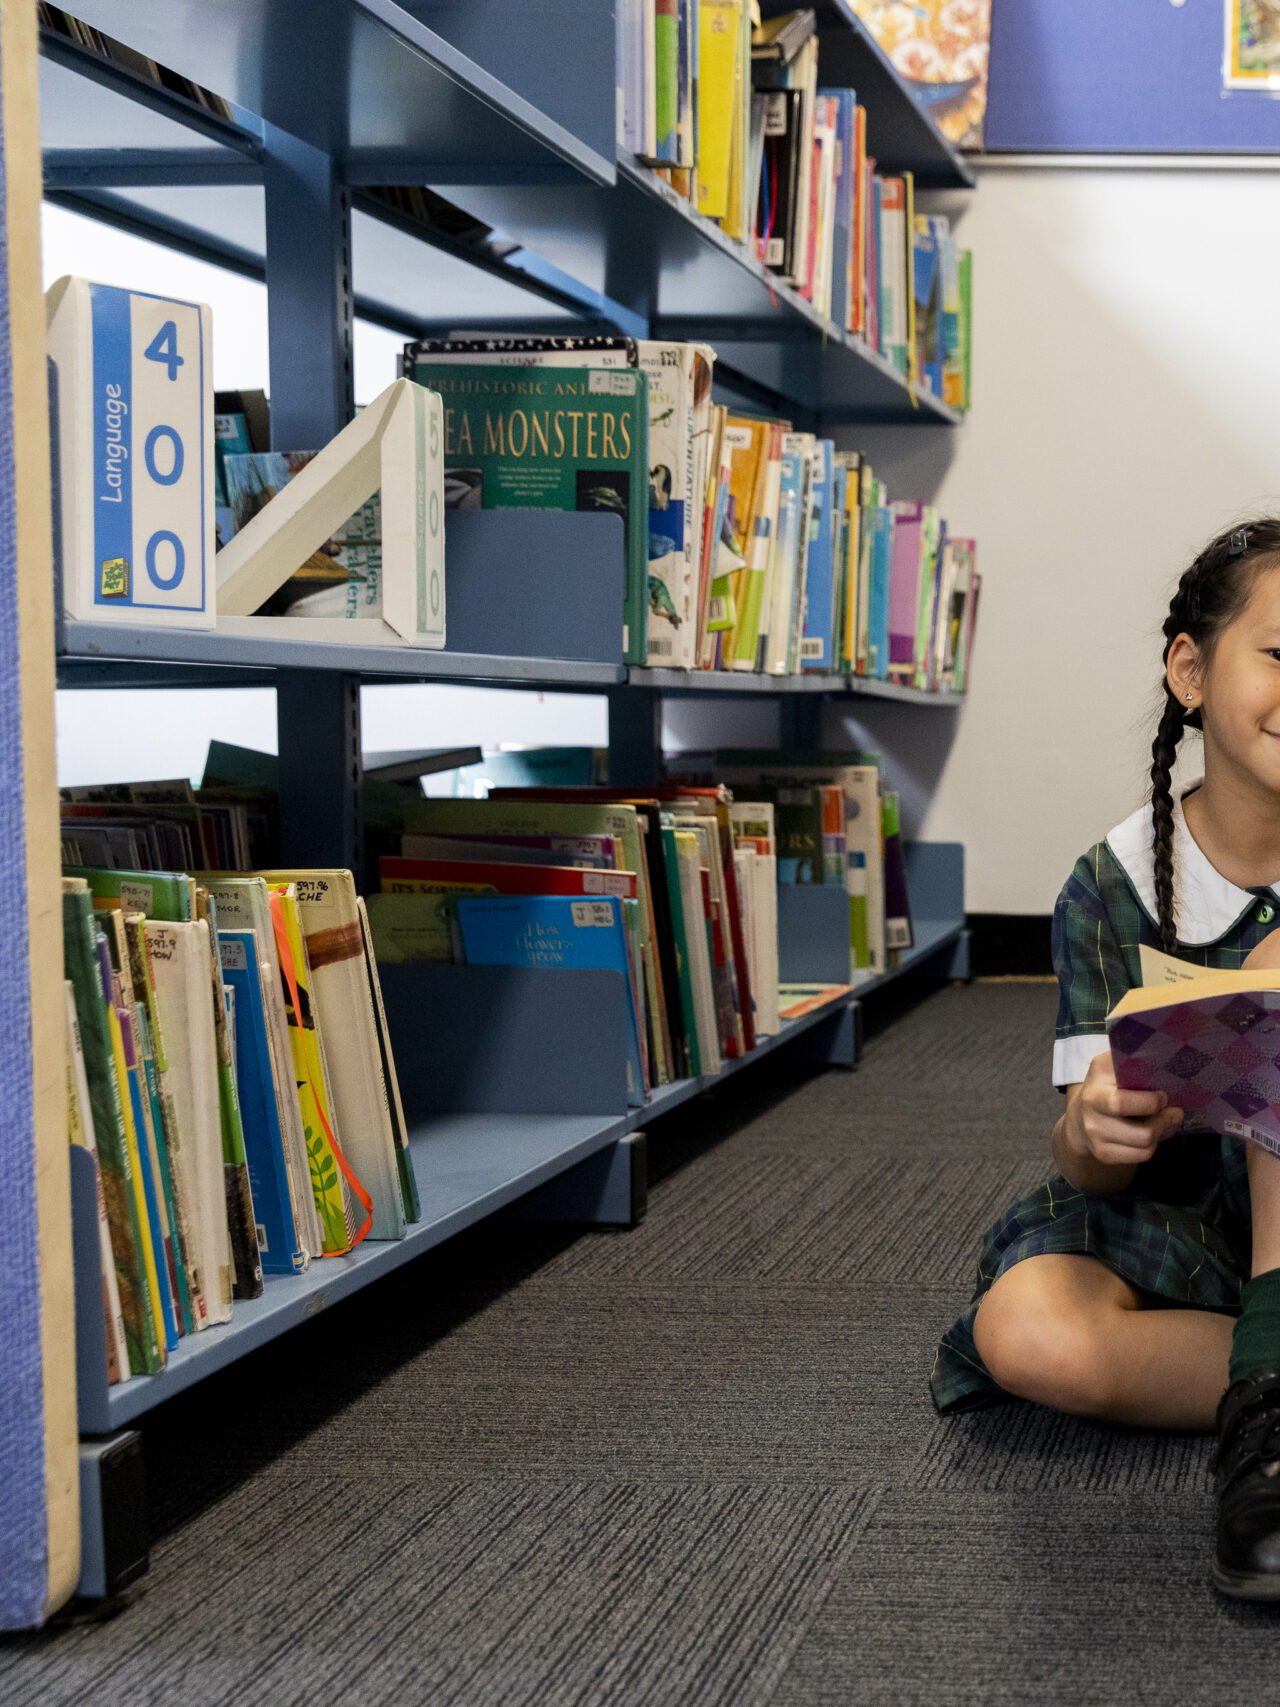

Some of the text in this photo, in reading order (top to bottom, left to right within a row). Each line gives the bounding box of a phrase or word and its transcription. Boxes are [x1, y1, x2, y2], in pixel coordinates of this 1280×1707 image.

[427, 378, 548, 397] PREHISTORIC
[100, 382, 132, 504] Language
[444, 408, 632, 461] EA MONSTERS
[296, 881, 329, 892] 597.96
